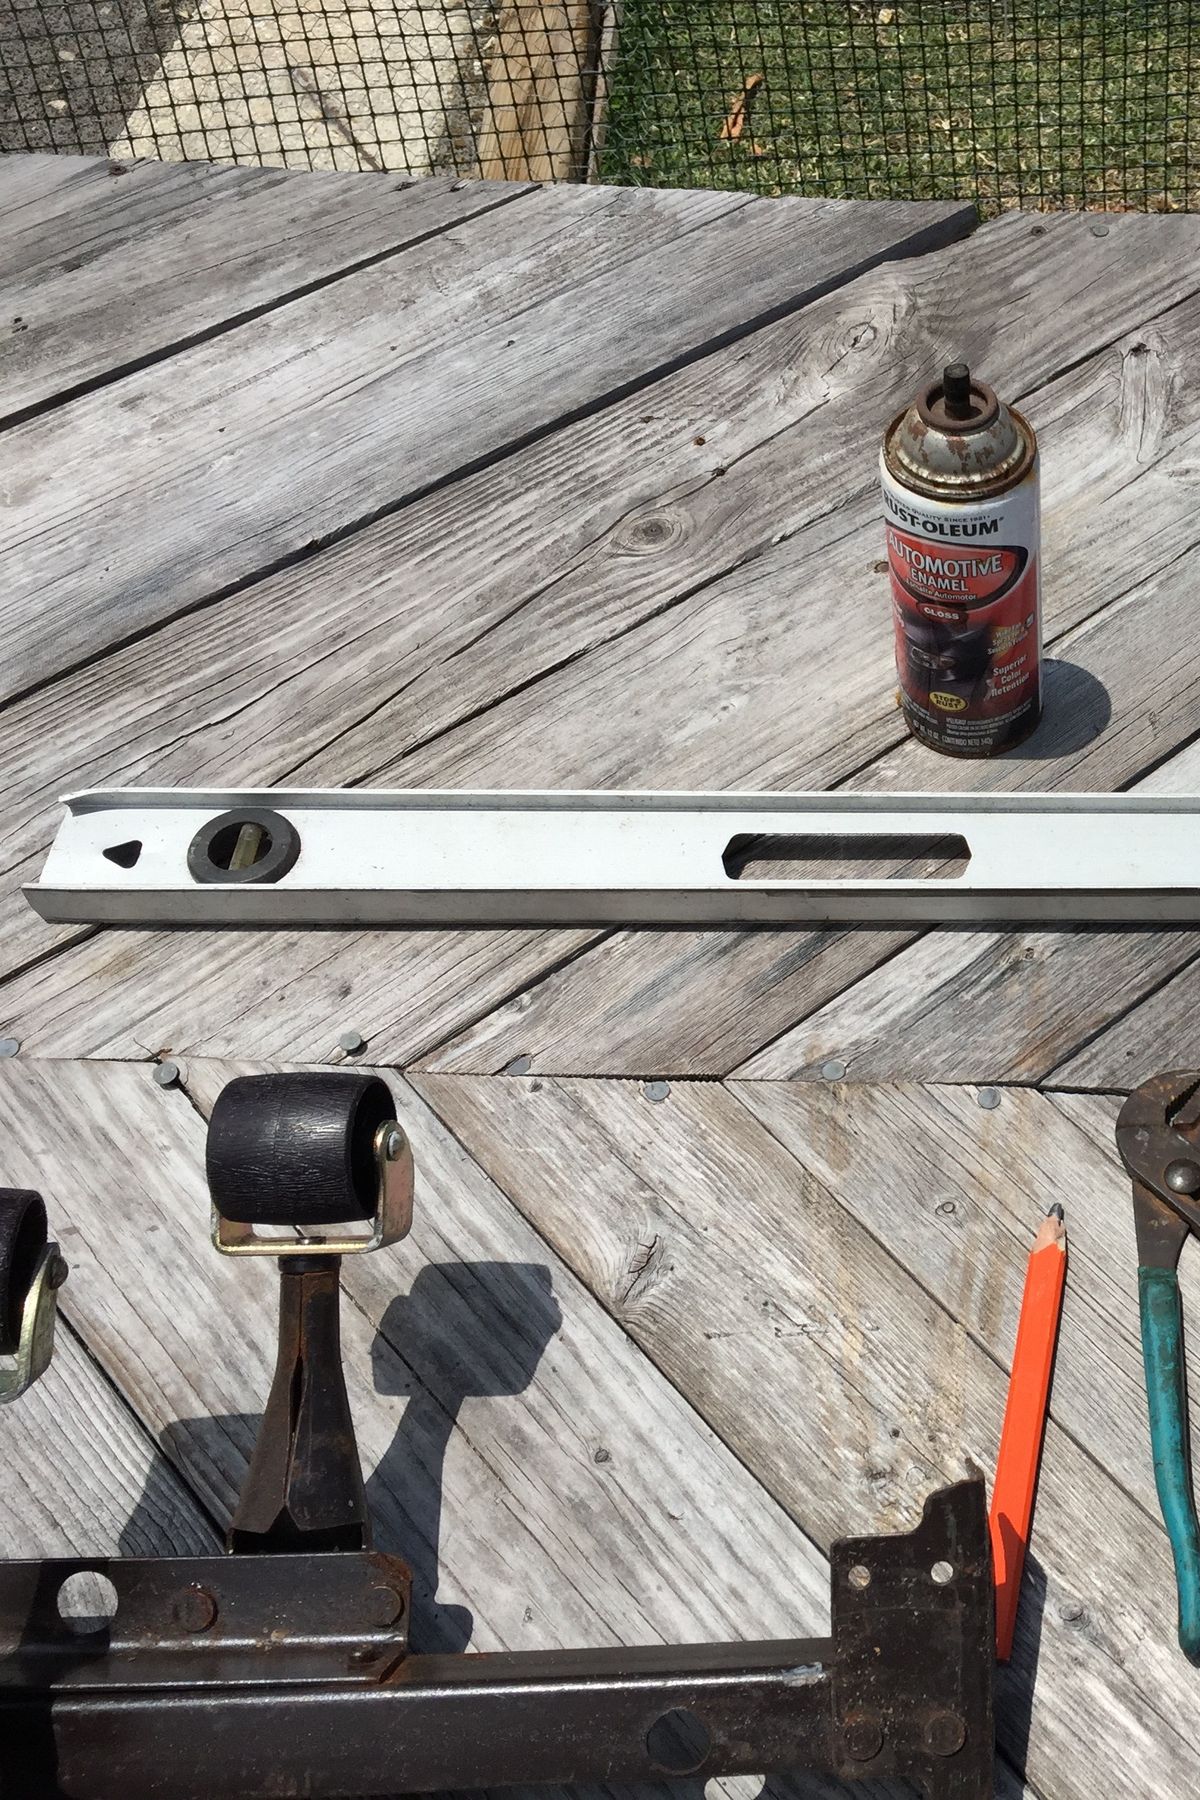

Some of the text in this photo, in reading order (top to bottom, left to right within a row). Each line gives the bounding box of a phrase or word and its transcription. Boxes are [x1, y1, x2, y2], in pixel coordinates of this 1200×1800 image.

[889, 530, 1003, 578] AUTOMOTIVE
[911, 568, 969, 592] ENAMEL
[924, 606, 960, 620] GLOSS
[992, 654, 1027, 677] Superior
[991, 672, 1030, 697] Retention
[1001, 670, 1021, 685] Color
[933, 693, 961, 704] STOPS
[936, 700, 959, 709] RUST
